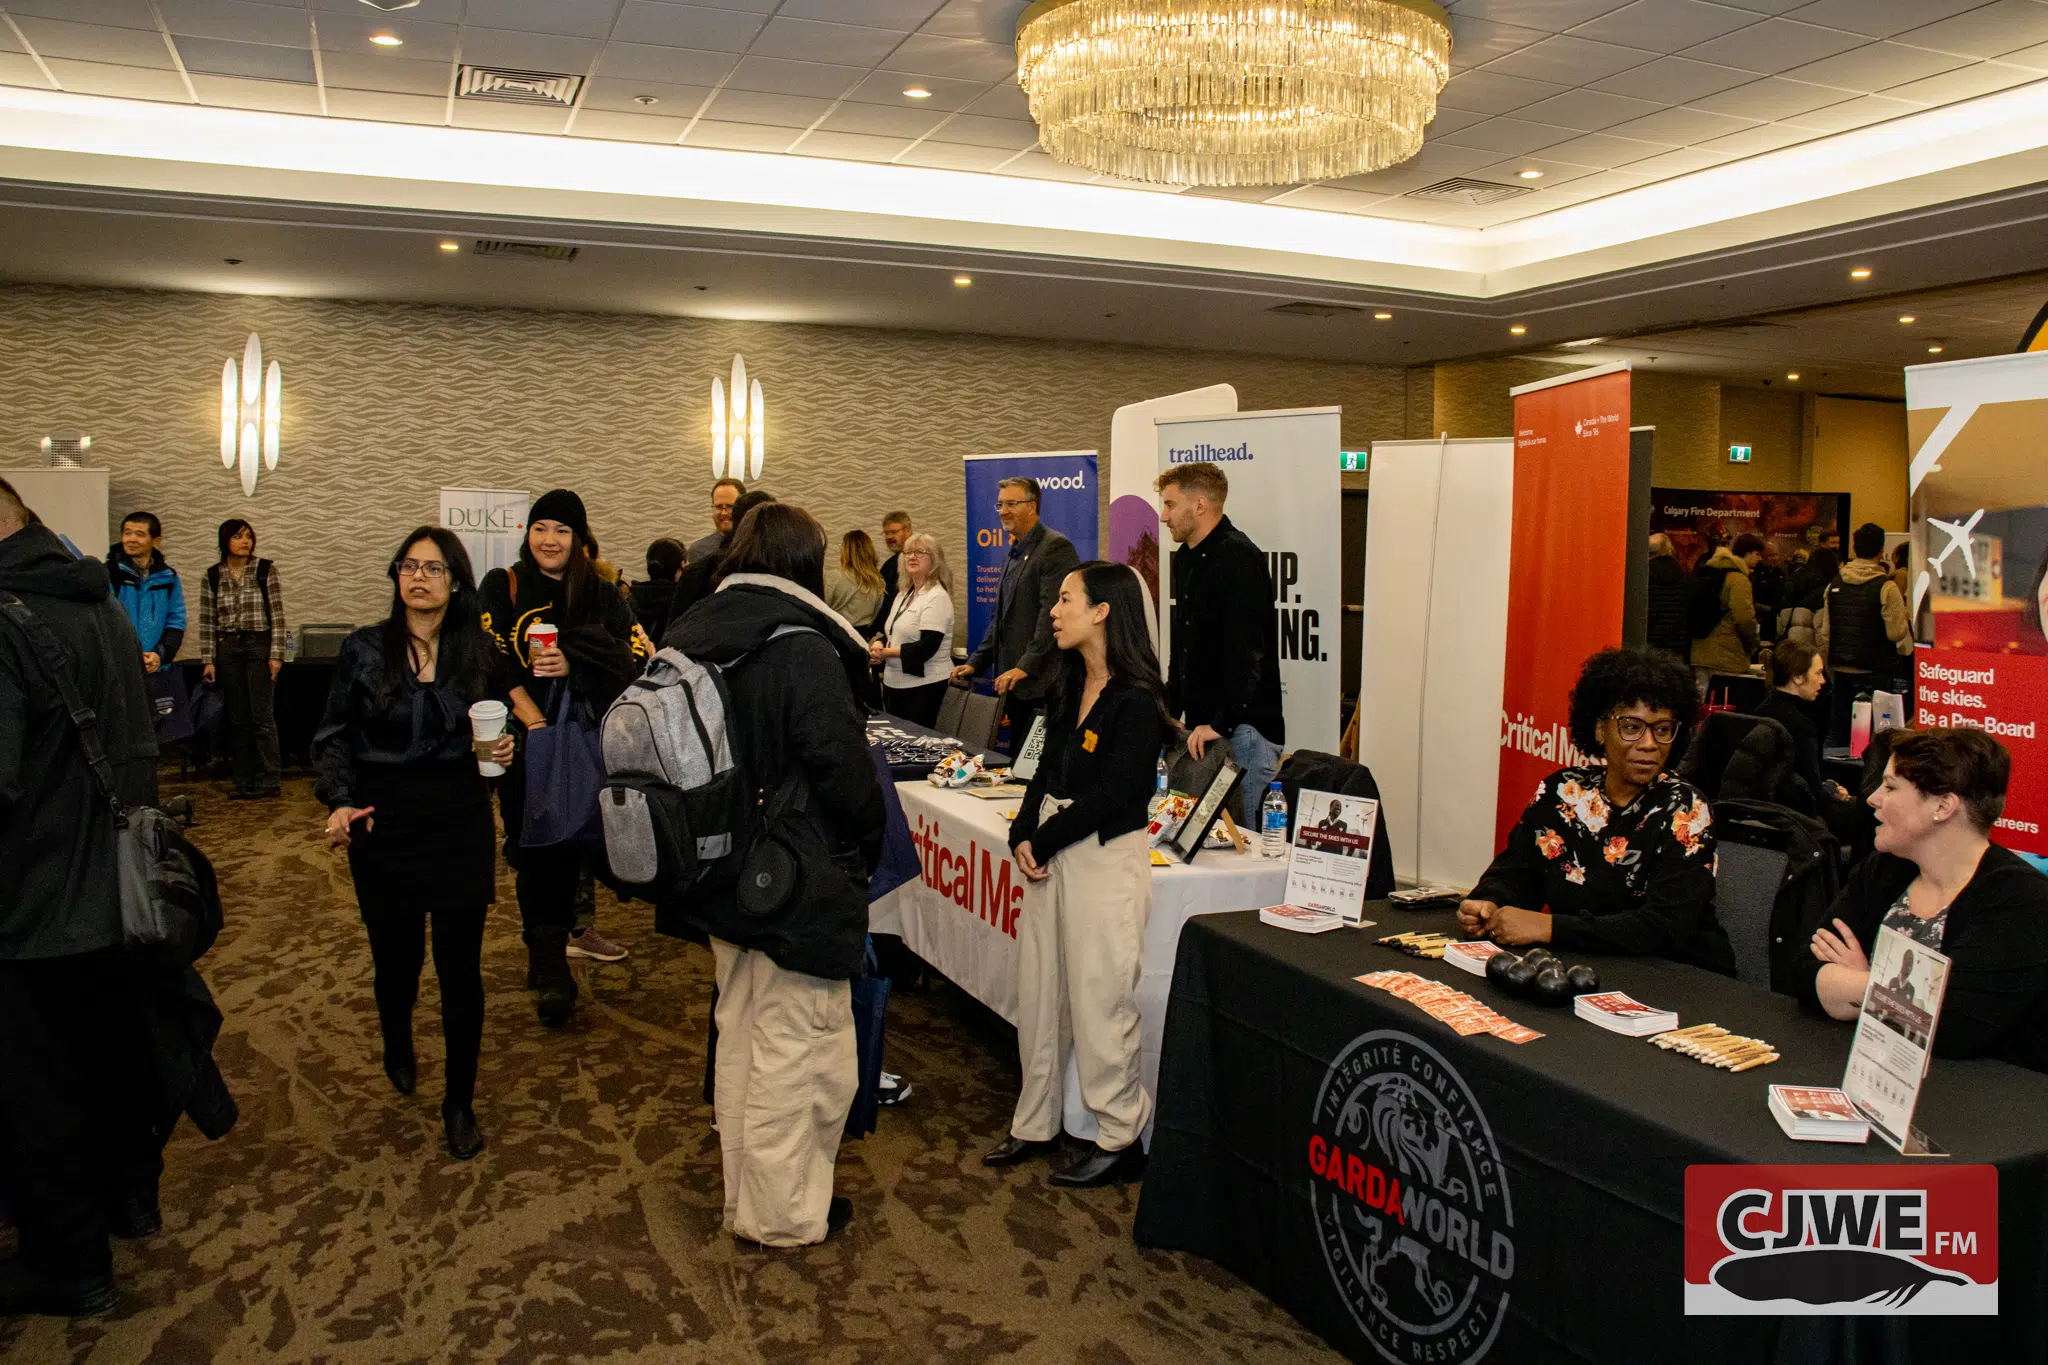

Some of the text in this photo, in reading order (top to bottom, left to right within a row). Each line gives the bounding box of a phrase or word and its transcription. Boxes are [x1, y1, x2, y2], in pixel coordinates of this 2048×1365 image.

[1169, 442, 1254, 463] trailhead.
[1036, 470, 1085, 490] wood.
[1663, 505, 1760, 518] Calgary Fire Department
[977, 528, 1003, 547] Oil
[1919, 662, 1995, 685] Safeguard
[1919, 686, 1939, 703] the
[1941, 689, 1987, 709] skies.
[1919, 708, 2035, 739] Be a Pre-Board
[1302, 829, 1318, 837] SECURE
[1339, 836, 1351, 844] WITH
[1994, 817, 2039, 834] areers
[1325, 1044, 1498, 1198] INTÉGRITÉ CONFIANCE
[1308, 1134, 1515, 1281] GARDAWORLD
[1323, 1214, 1489, 1363] VIGILANCE RESPECT
